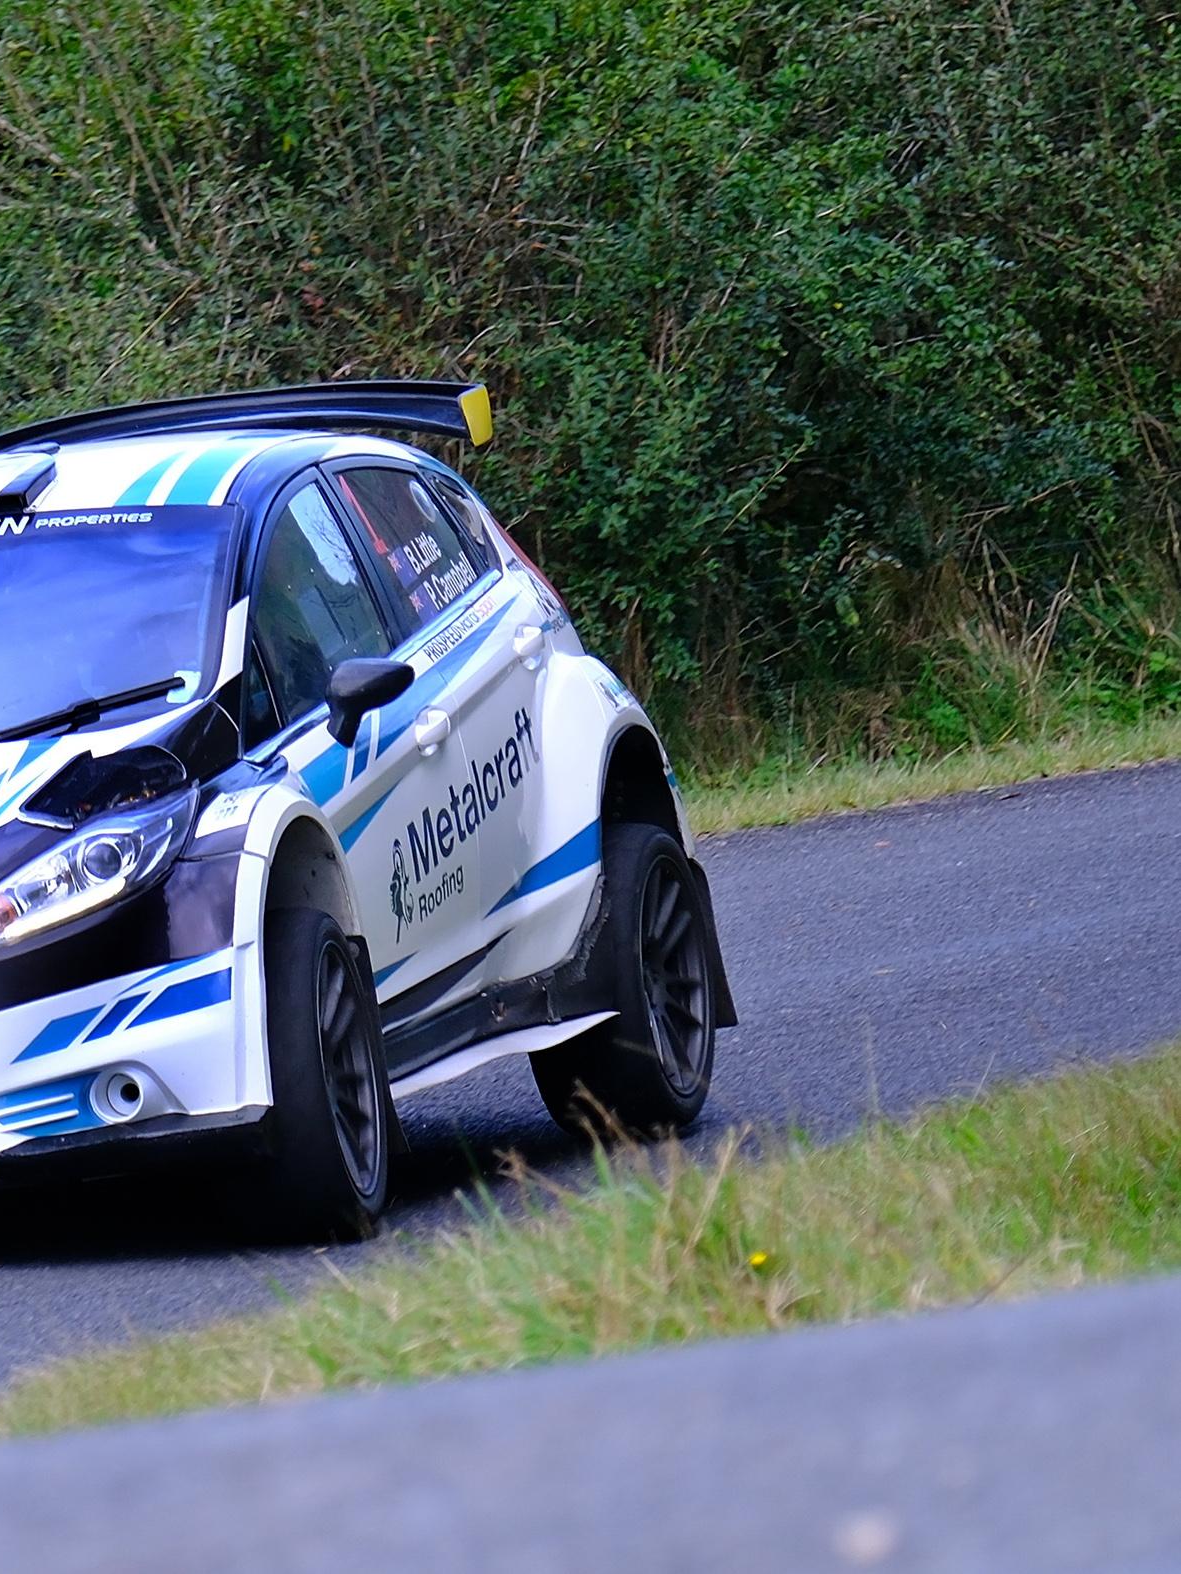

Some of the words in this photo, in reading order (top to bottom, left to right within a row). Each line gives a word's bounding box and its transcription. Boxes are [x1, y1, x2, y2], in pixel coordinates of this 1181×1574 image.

[34, 512, 154, 529] PROPERTIES
[406, 707, 540, 884] Metalcraft
[418, 865, 464, 923] Roofing
